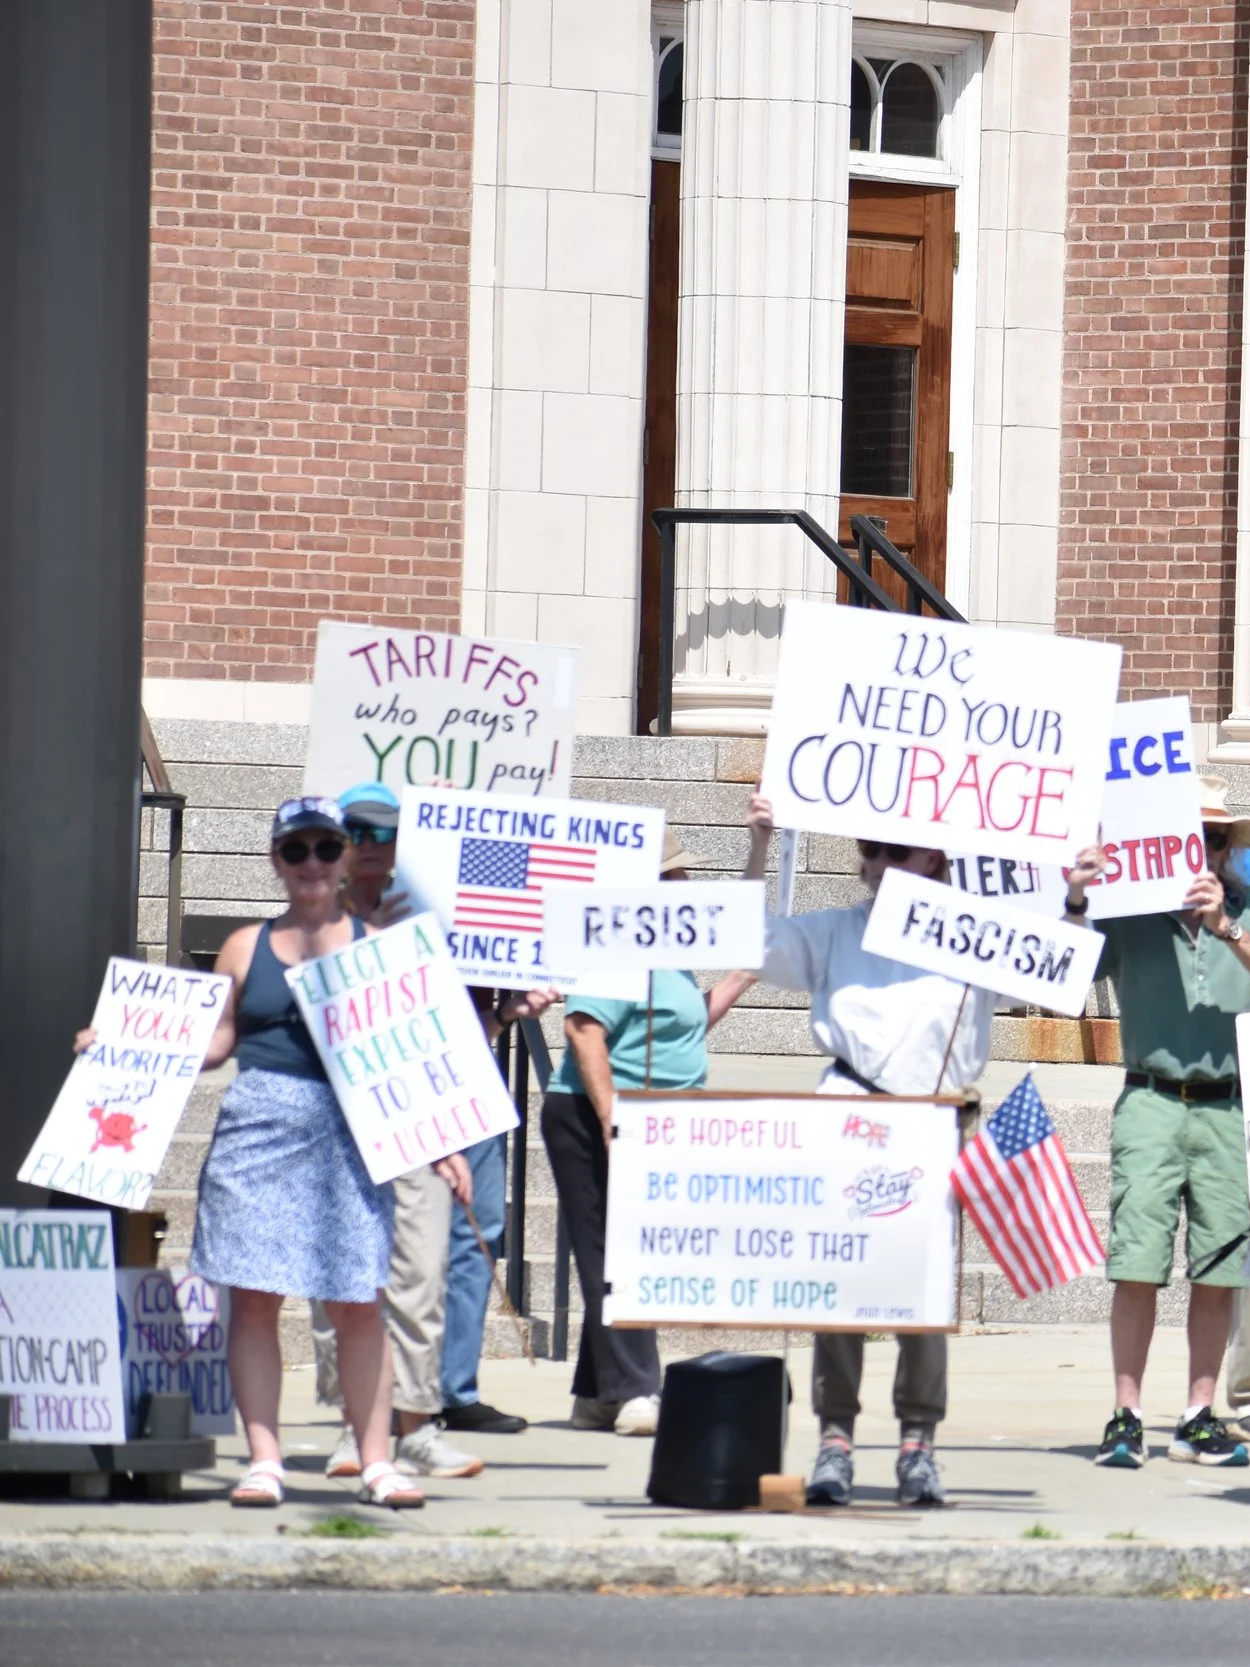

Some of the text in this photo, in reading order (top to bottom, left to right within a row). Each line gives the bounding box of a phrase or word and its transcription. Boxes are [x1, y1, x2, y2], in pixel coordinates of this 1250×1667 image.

[348, 634, 539, 708] TARIFFS
[893, 631, 977, 688] We
[353, 693, 539, 742] who pays?
[837, 682, 1064, 755] NEED YOUR
[362, 732, 561, 797] YOU pay!
[1104, 730, 1193, 782] ICE
[787, 733, 1076, 841] COURAGE
[417, 802, 646, 849] REJECTING KINGS
[1062, 832, 1204, 886] STAPO
[446, 932, 519, 966] SINCE
[582, 904, 726, 948] RESIST
[900, 897, 1076, 988] FASCISM
[111, 964, 225, 1009] WHAT'S
[299, 922, 434, 1006] ELECT A
[119, 1003, 199, 1046] YOUR
[321, 964, 432, 1047] RAPIST
[77, 1039, 199, 1077] FAVORITE
[335, 1006, 449, 1087] EXPECT
[367, 1050, 466, 1120] TO BE
[686, 1174, 826, 1207] OPTIMISTIC
[141, 1281, 214, 1314] LOCAL
[731, 1278, 760, 1308] OF
[133, 1322, 225, 1354] TRUSTED
[34, 1392, 113, 1432] PROCESS
